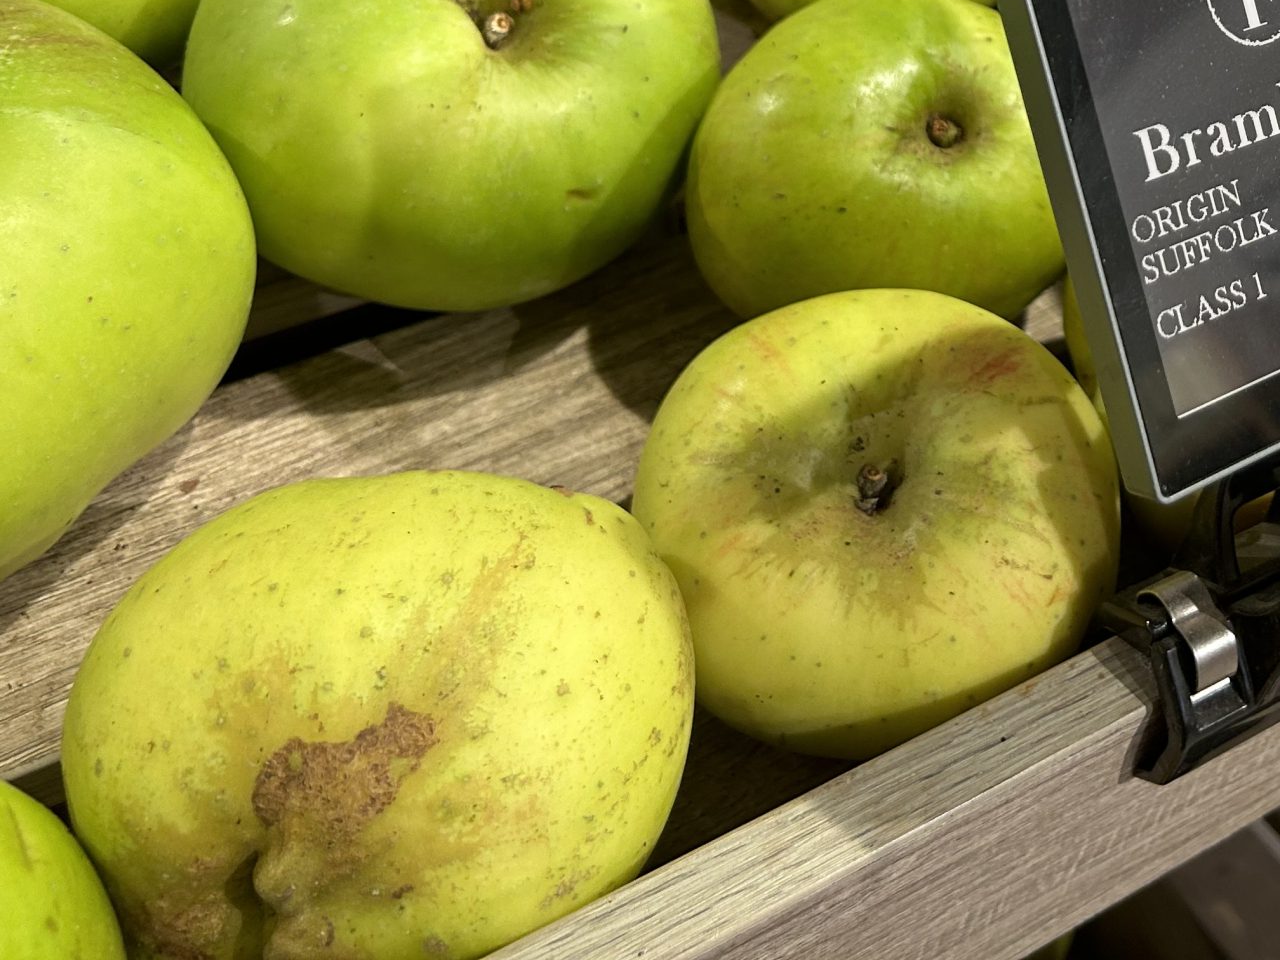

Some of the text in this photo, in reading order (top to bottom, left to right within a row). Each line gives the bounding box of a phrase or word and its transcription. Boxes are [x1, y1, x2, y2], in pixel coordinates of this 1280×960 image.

[1131, 179, 1242, 243] ORIGIN
[1141, 208, 1279, 285] SUFFOLK
[1156, 271, 1268, 339] CLASS 1
